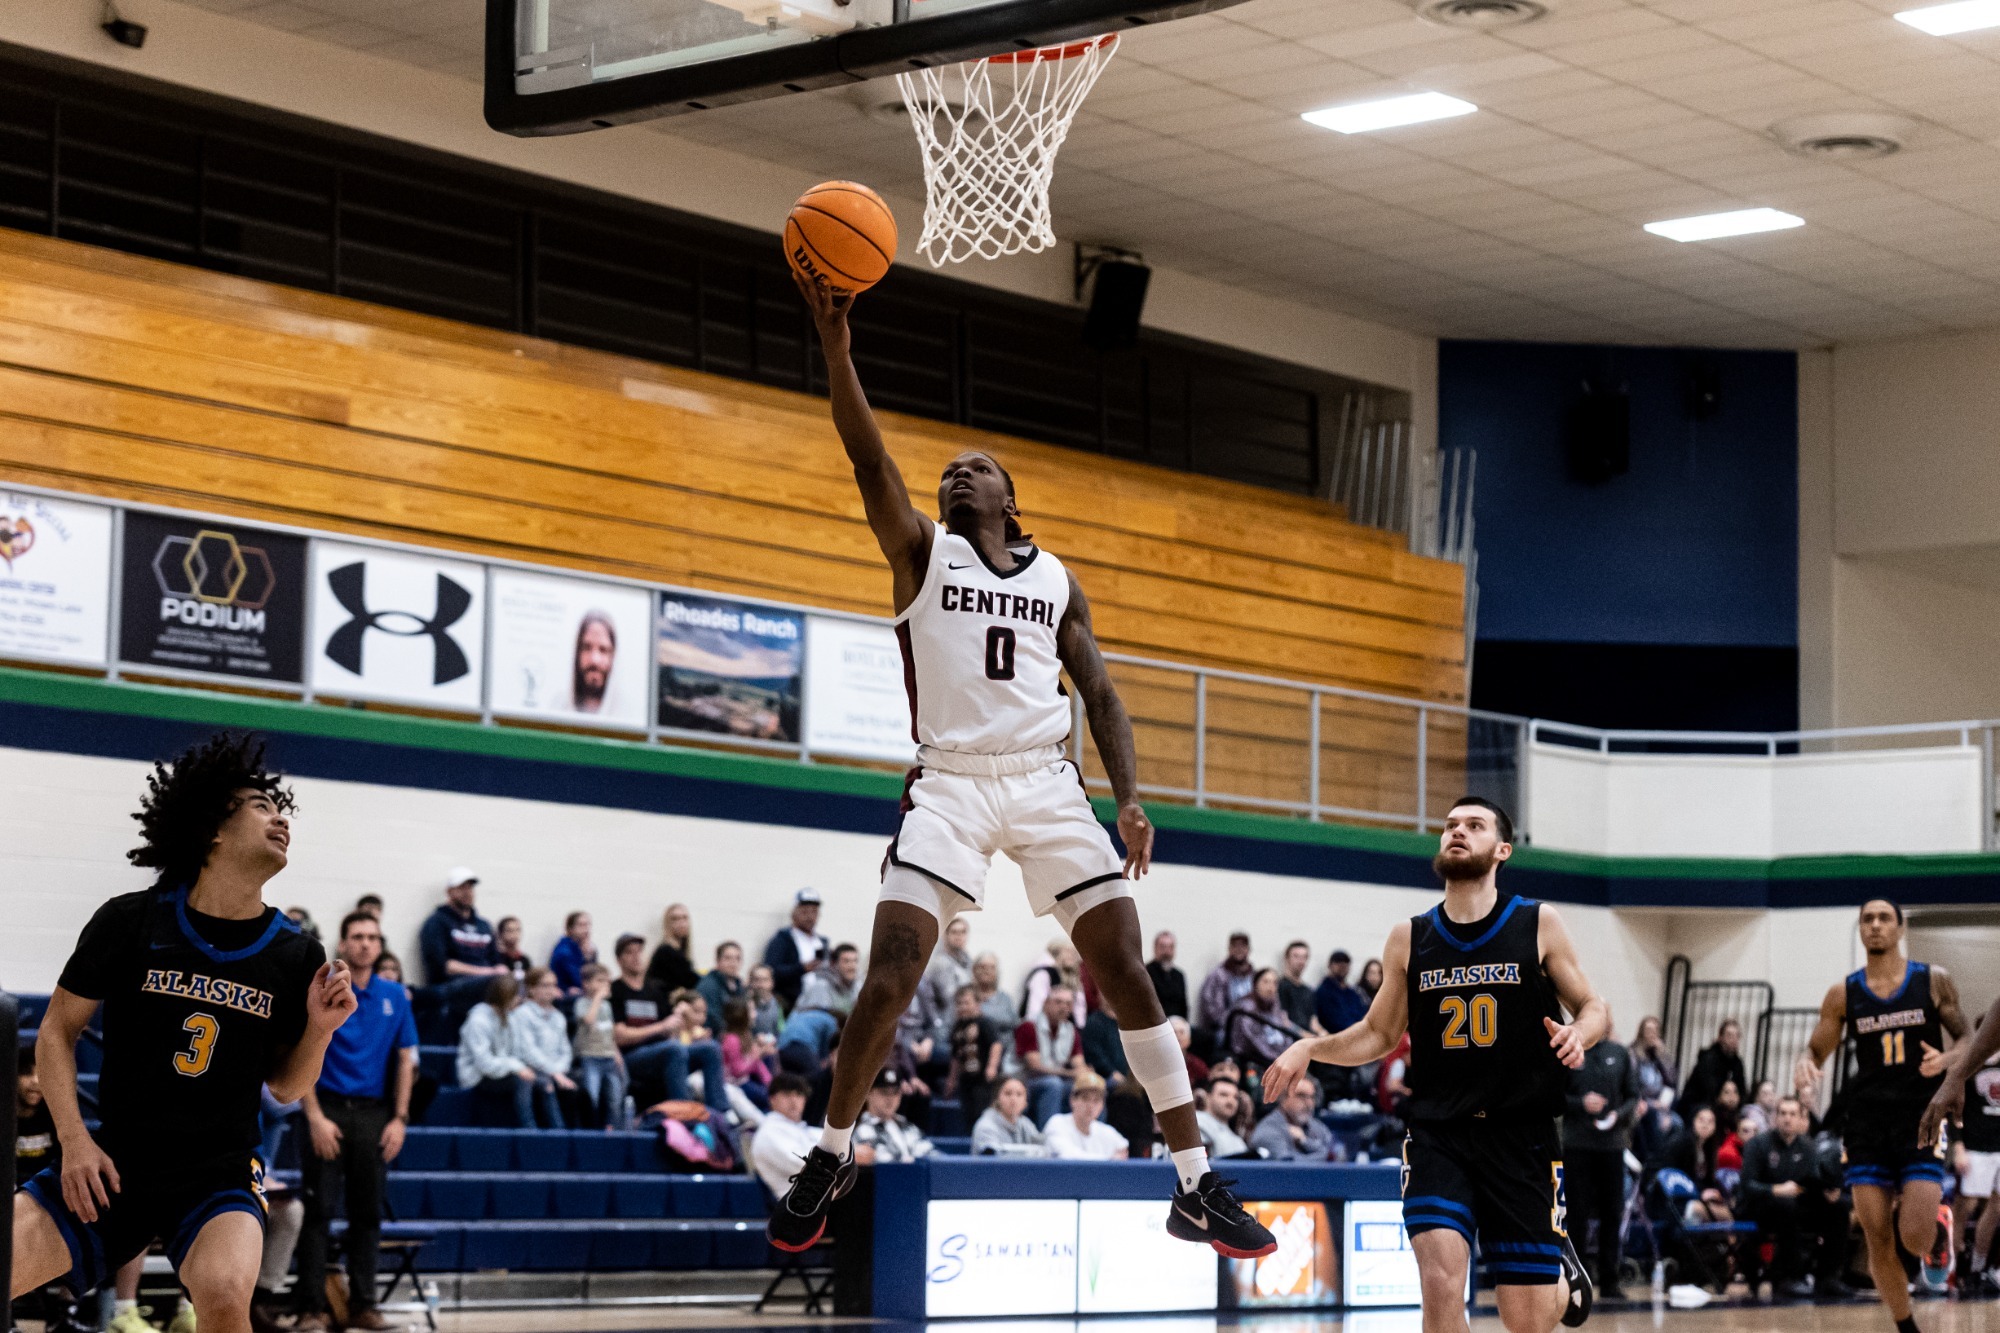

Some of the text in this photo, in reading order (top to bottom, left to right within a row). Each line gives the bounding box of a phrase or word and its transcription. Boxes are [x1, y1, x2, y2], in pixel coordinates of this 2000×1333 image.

[160, 597, 267, 634] PODIUM
[664, 600, 797, 639] Rhoades Ranch
[941, 584, 1055, 629] CENTRAL
[985, 625, 1017, 681] 0
[141, 969, 274, 1019] ALASKA
[1419, 963, 1521, 992] ALASKA
[1439, 993, 1498, 1049] 20
[172, 1012, 220, 1078] 3
[1881, 1030, 1905, 1066] 11
